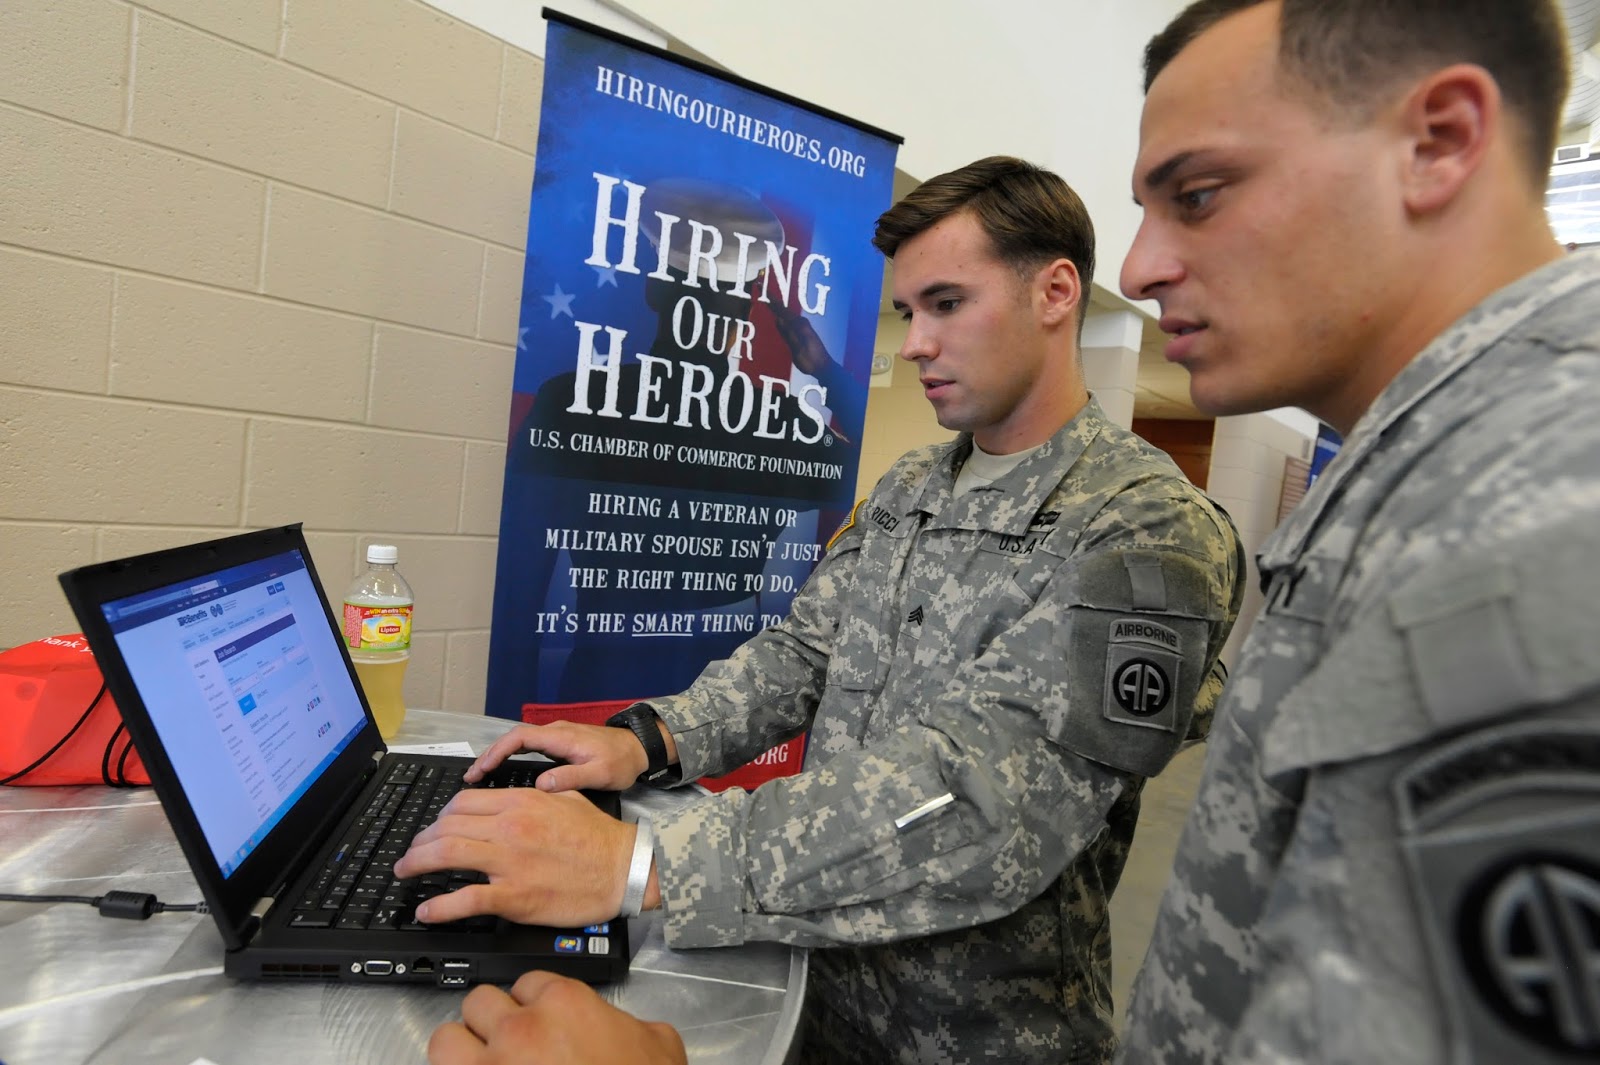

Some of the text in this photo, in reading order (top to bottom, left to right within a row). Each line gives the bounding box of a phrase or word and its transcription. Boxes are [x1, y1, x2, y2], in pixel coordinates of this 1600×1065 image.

[595, 65, 867, 178] HIRINGOURHEROES.ORG
[584, 171, 831, 316] HIRING
[672, 296, 756, 361] OUR
[566, 320, 827, 444] HEROES
[529, 428, 843, 480] U.S. CHAMBER OF COMMERCE FOUNDATION
[588, 492, 797, 527] HIRING A VETERAN OR
[871, 506, 900, 533] RICCI
[545, 528, 821, 562] MILITARY SPOUSE ISN'T JUST
[569, 567, 798, 593] THE RIGHT THING TO DO.
[535, 604, 781, 637] IT'S THE SMART THING TO
[1114, 624, 1177, 648] AIRBORNE
